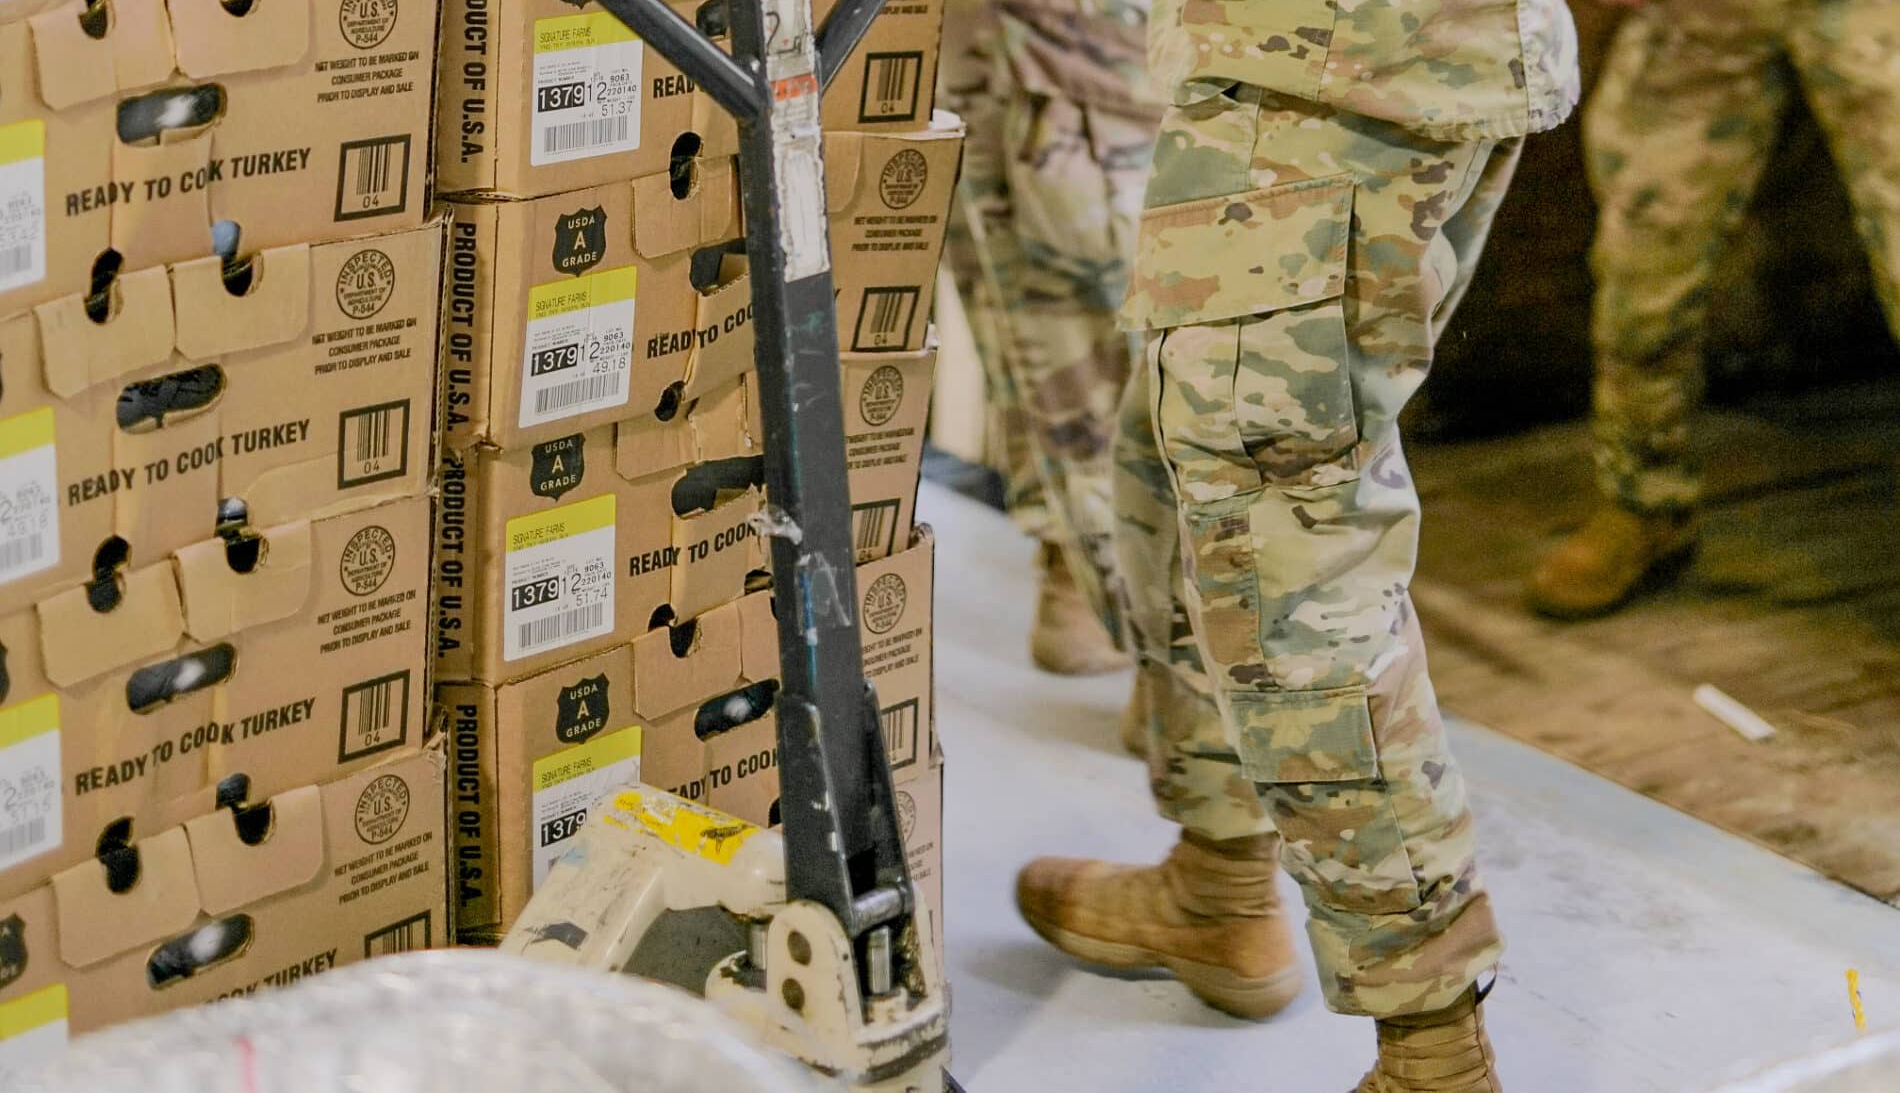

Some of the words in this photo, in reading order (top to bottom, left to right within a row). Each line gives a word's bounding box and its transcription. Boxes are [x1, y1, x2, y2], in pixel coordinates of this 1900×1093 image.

[360, 1, 380, 19] U.S.
[356, 33, 378, 44] P-544
[540, 29, 570, 44] SIGNATURE
[572, 27, 592, 37] FARMS
[464, 54, 486, 80] OF
[540, 85, 584, 110] 1379
[587, 81, 608, 103] 12
[653, 75, 695, 99] READ
[462, 87, 486, 163] U.S.A.
[66, 181, 136, 217] READY
[144, 176, 172, 201] TO
[180, 159, 224, 193] COOK
[231, 147, 312, 178] TURKEY
[362, 197, 380, 209] 04
[568, 216, 596, 229] USDA
[574, 231, 586, 250] A
[340, 252, 392, 285] INSPECTED
[562, 251, 598, 268] GRADE
[356, 271, 377, 289] U.S.
[453, 222, 476, 327] PRODUCT
[536, 297, 566, 312] SIGNATURE
[566, 292, 587, 303] FARMS
[450, 334, 474, 362] OF
[697, 324, 718, 349] TO
[533, 347, 578, 373] 1379
[581, 341, 600, 362] 12
[447, 369, 471, 432] U.S.A.
[544, 439, 574, 453] USDA
[68, 469, 136, 505] READY
[145, 457, 170, 481] TO
[176, 436, 225, 474] COOK
[232, 419, 311, 457] TURKEY
[364, 461, 380, 474] 04
[552, 455, 564, 474] A
[540, 475, 576, 491] GRADE
[513, 527, 546, 545] SIGNATURE
[546, 523, 566, 537] FARMS
[344, 529, 392, 563] INSPECTED
[360, 547, 378, 566] U.S.
[630, 547, 681, 577] READY
[688, 544, 708, 563] TO
[356, 577, 377, 591] P-544
[441, 559, 463, 587] OF
[513, 577, 558, 608] 1379
[562, 573, 582, 595] 12
[438, 595, 462, 658] U.S.A.
[570, 683, 598, 700] USDA
[576, 701, 589, 719] A
[566, 718, 600, 737] GRADE
[75, 753, 148, 795] READY
[152, 743, 172, 767] TO
[180, 715, 234, 753] COOK
[240, 698, 316, 739] TURKEY
[364, 733, 381, 747] 04
[455, 705, 478, 805] PRODUCT
[572, 757, 592, 771] FARMS
[710, 765, 732, 789] TO
[374, 797, 392, 815] U.S.
[459, 811, 482, 841] OF
[460, 845, 482, 909] U.S.A.
